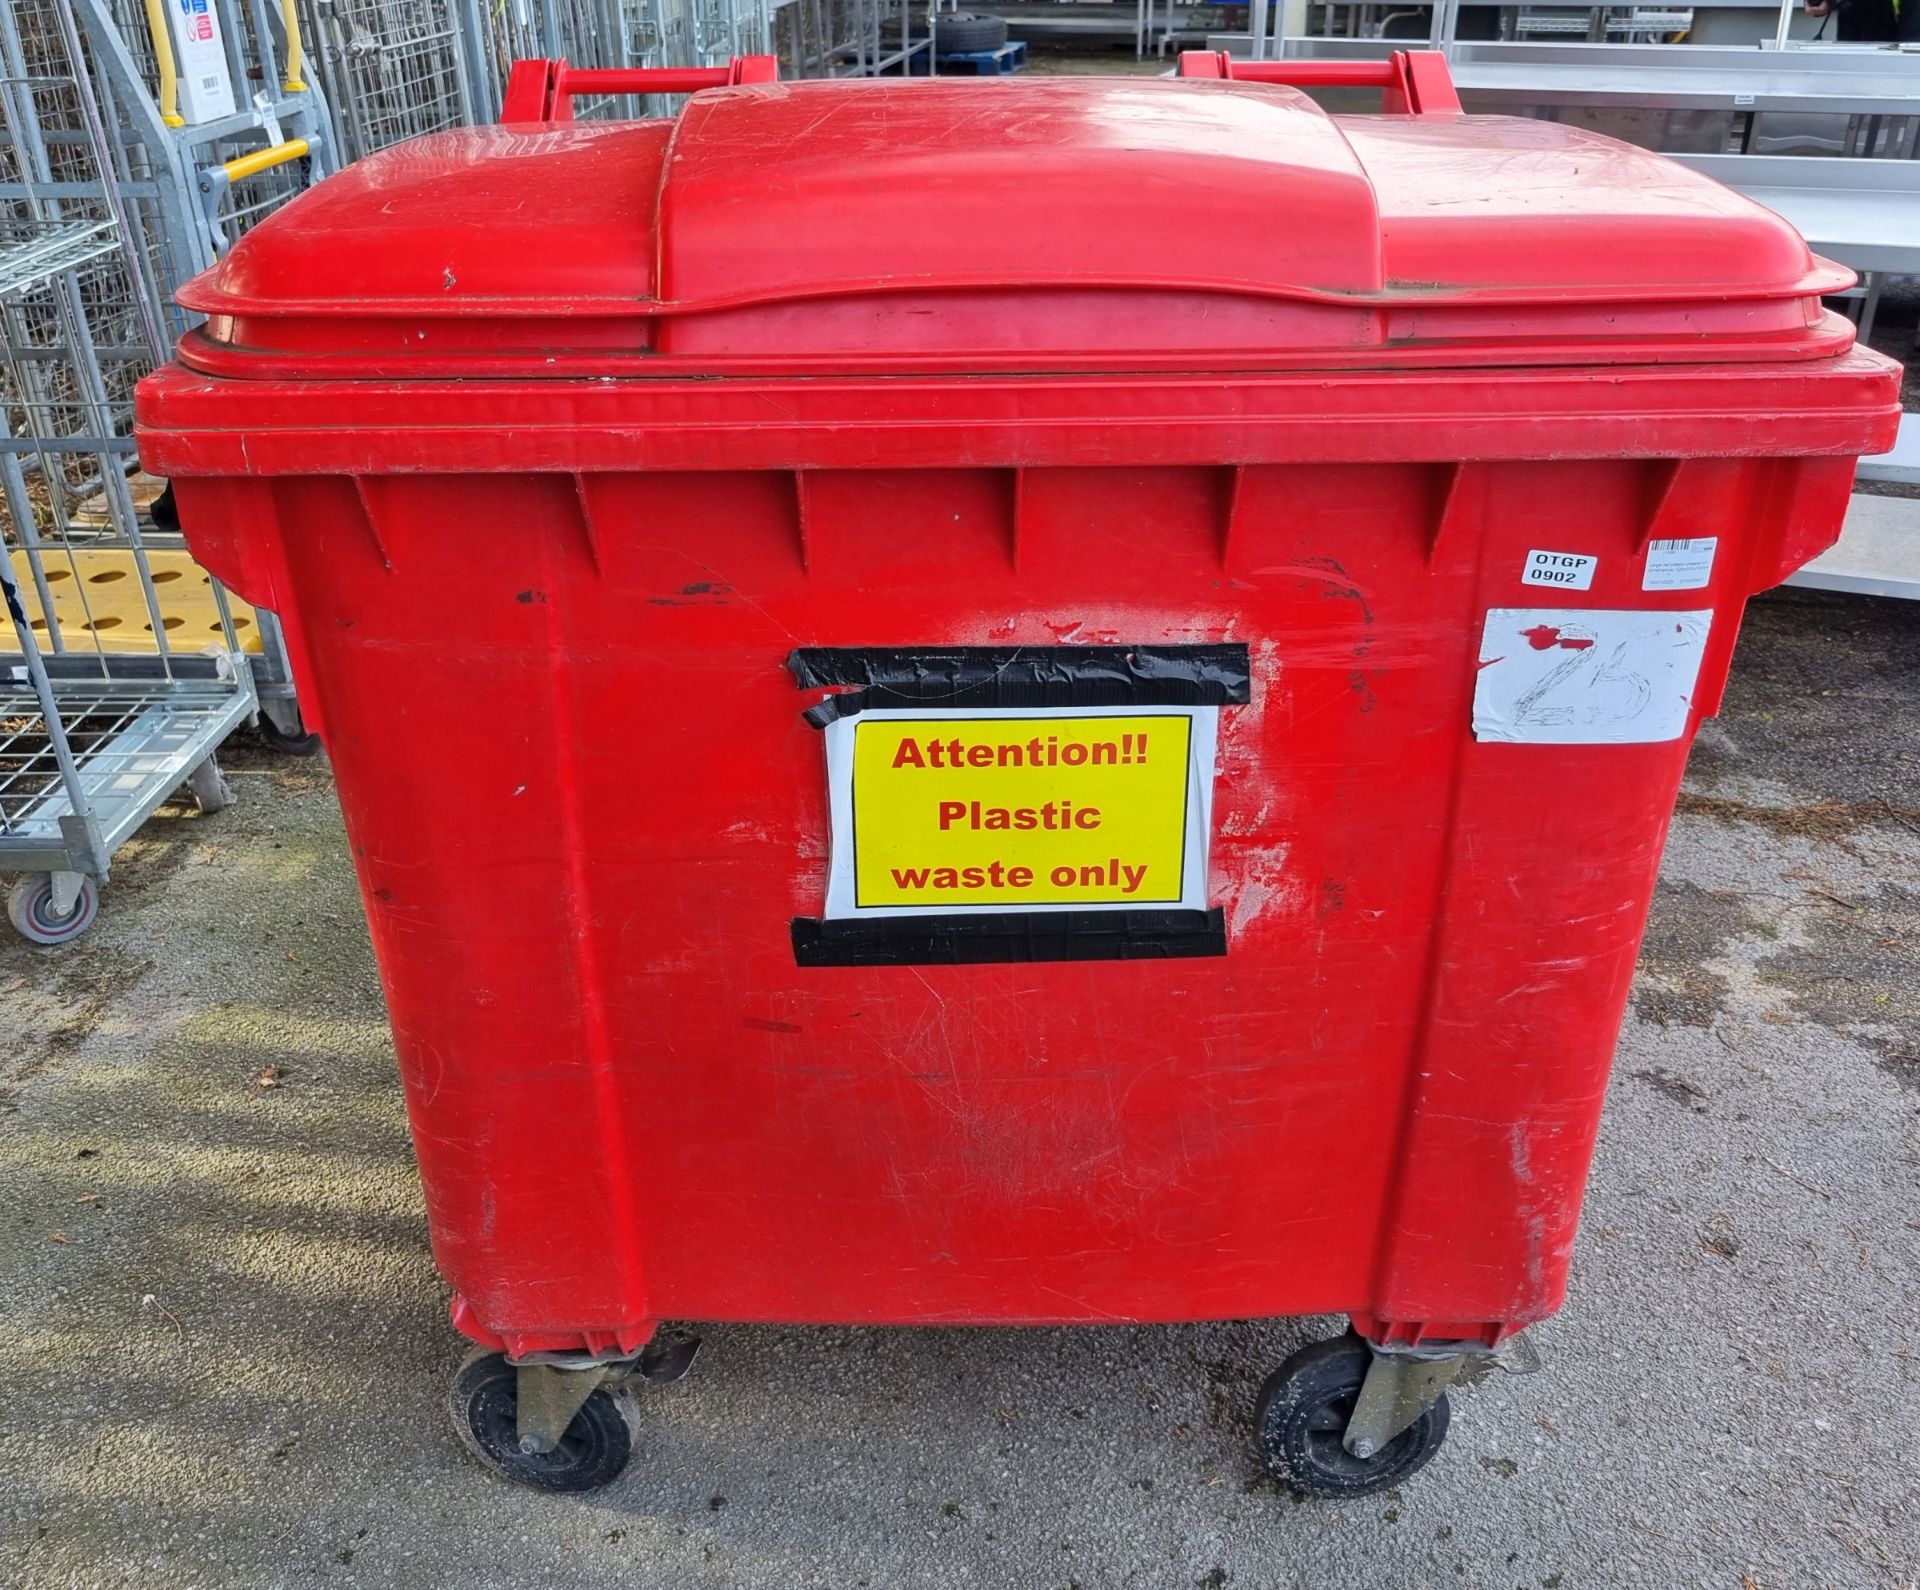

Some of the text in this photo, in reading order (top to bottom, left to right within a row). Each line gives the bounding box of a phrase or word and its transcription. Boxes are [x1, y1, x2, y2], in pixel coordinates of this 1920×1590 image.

[1531, 569, 1577, 584] 0902
[1536, 554, 1588, 568] OTGP
[892, 733, 1148, 769] Attention!!
[939, 800, 1102, 831] Plastic
[891, 858, 1148, 894] waste only
